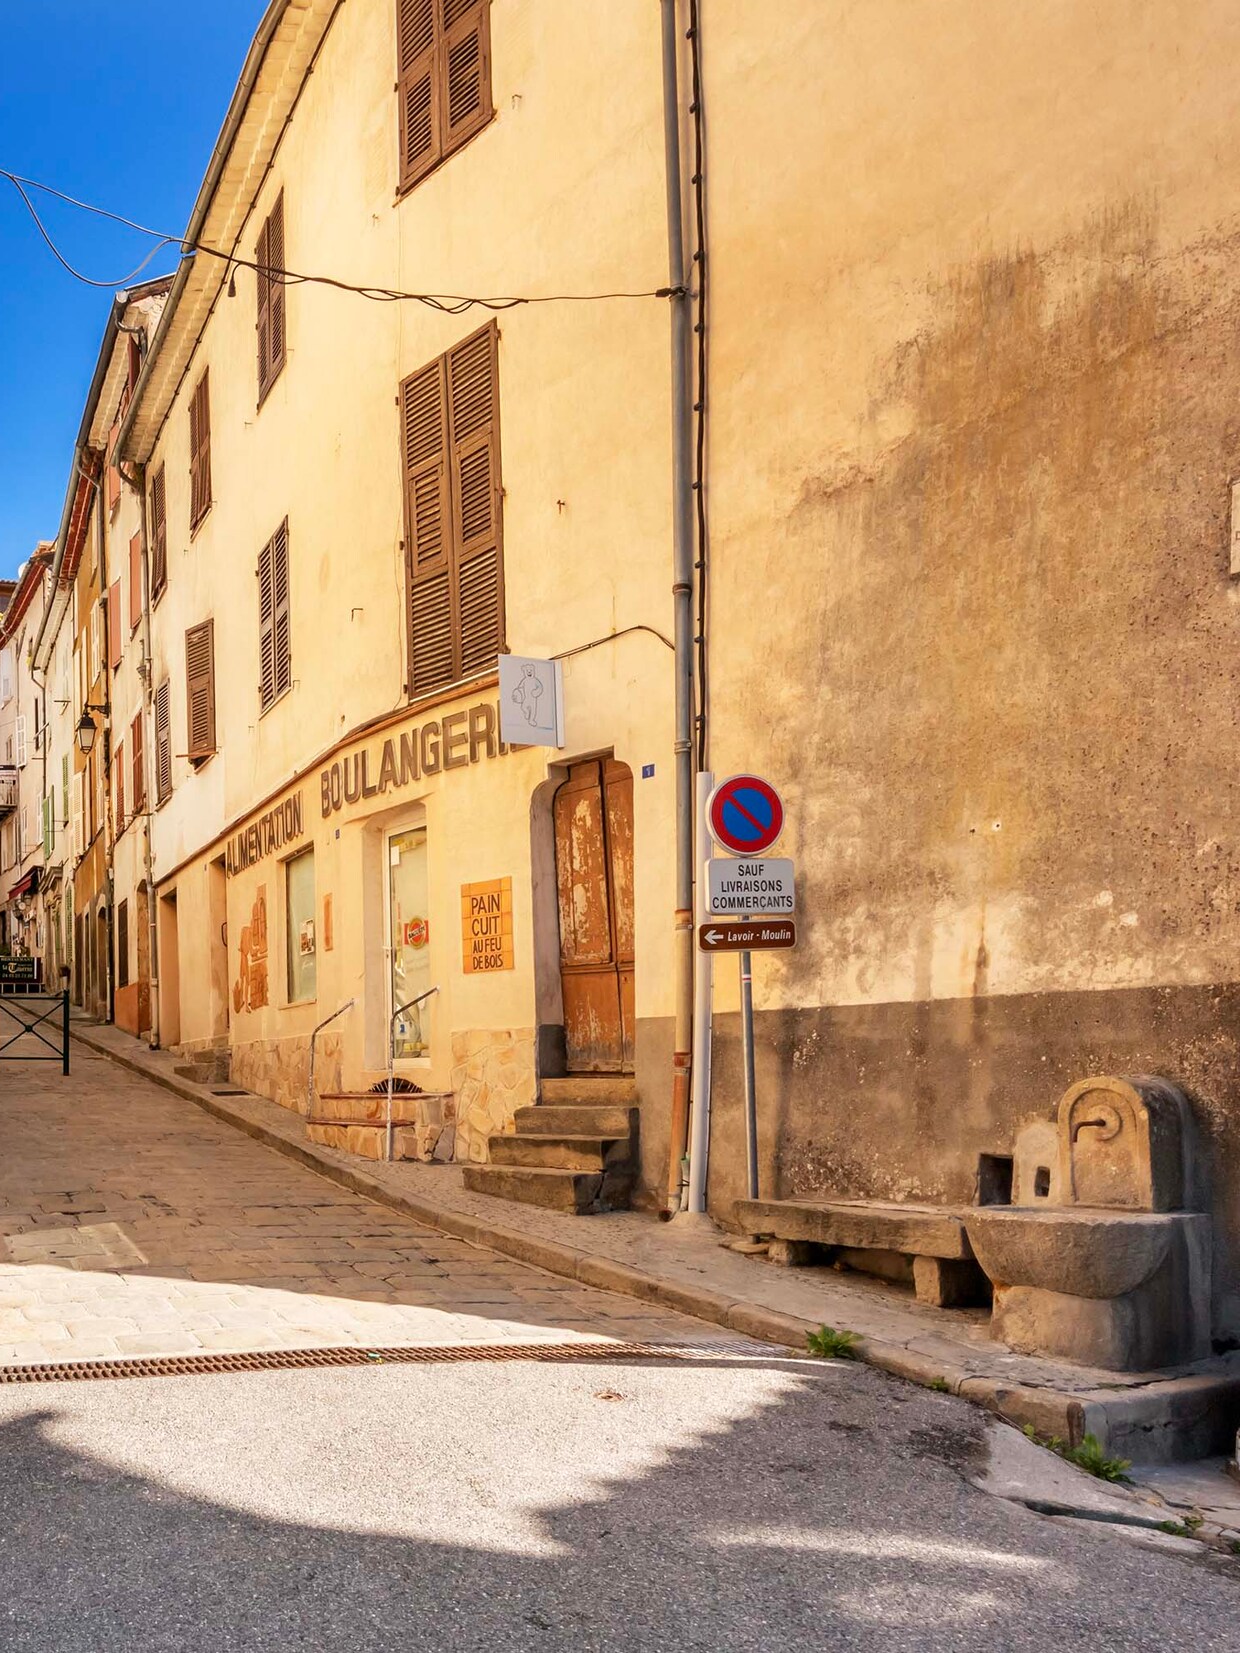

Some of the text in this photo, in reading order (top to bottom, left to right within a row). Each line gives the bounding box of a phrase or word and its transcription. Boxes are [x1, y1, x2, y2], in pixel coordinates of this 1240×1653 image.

[321, 700, 537, 819] BOULANGER
[225, 790, 304, 880] ALIMENTATION
[738, 864, 765, 876] SAUF
[721, 880, 783, 892] LIVRAISONS
[471, 893, 500, 915] PAIN
[712, 895, 793, 910] COMMERÇANTS
[472, 915, 500, 936] CUIT
[727, 931, 754, 942] Lavoir
[761, 929, 791, 940] Moulin
[473, 937, 502, 954] AU FEU
[473, 954, 504, 970] DE BOIS
